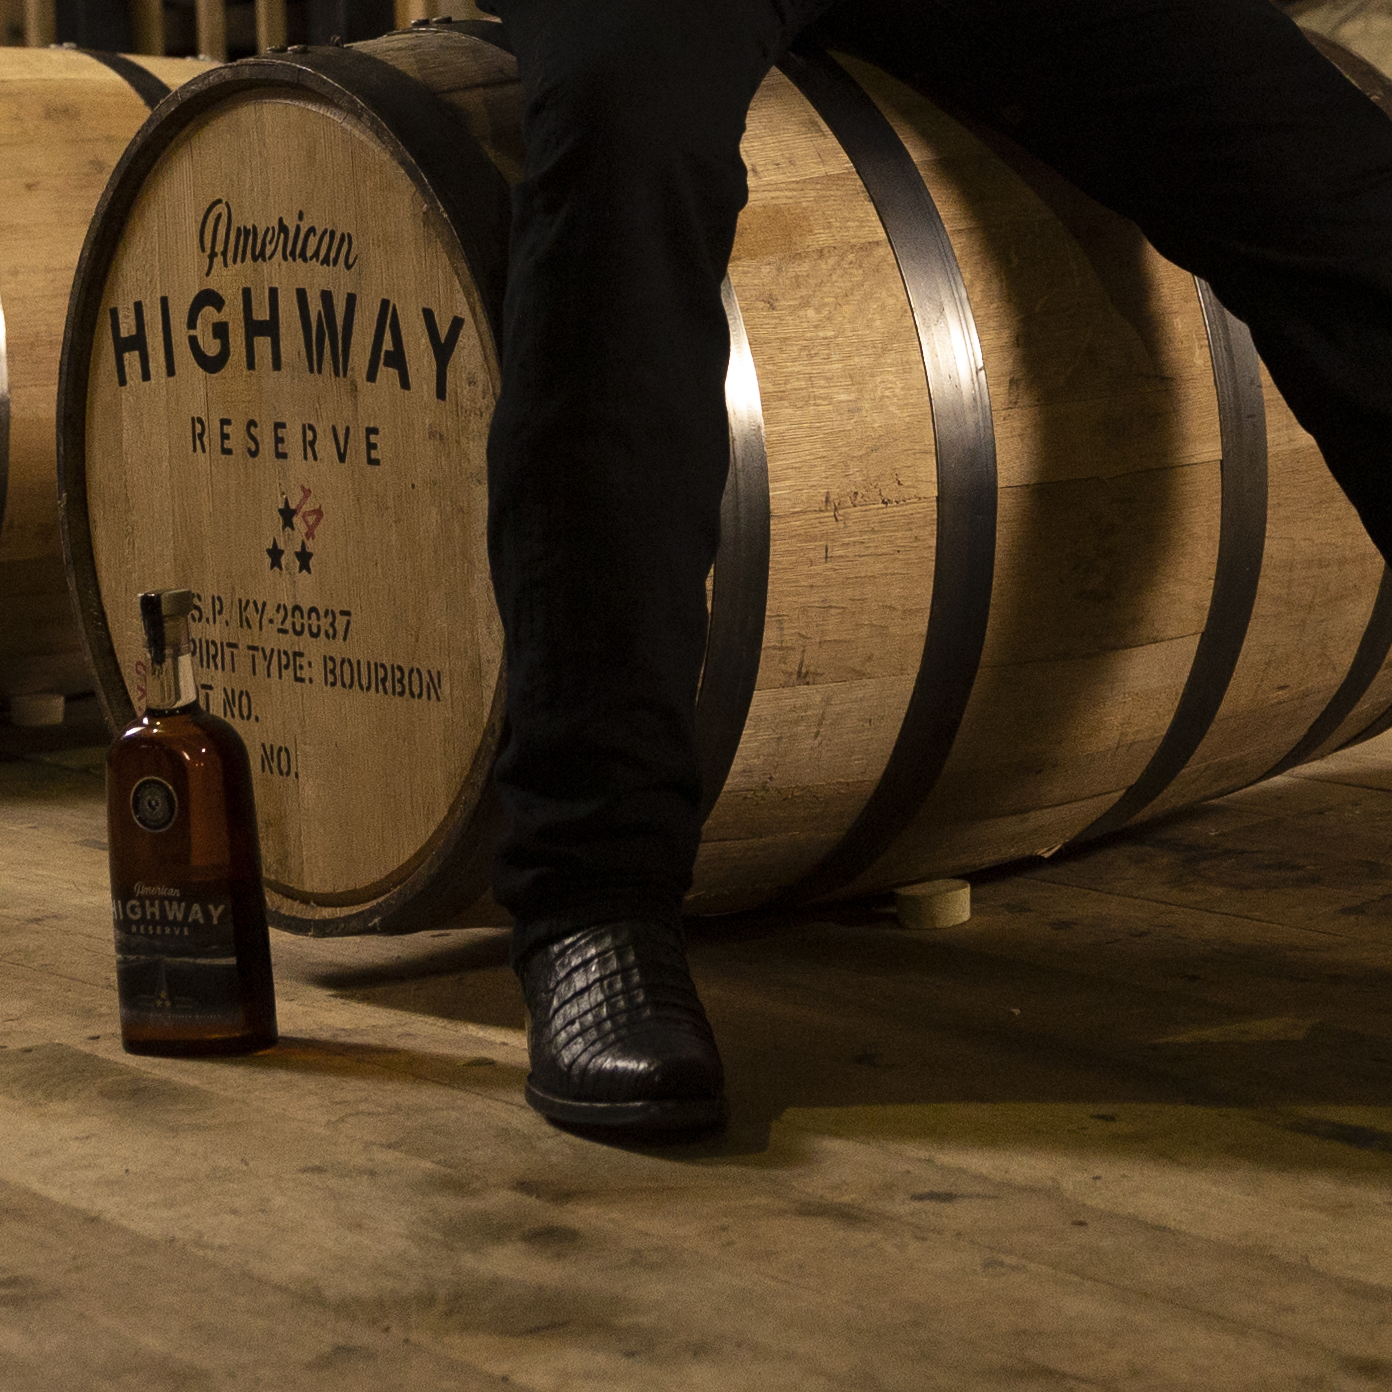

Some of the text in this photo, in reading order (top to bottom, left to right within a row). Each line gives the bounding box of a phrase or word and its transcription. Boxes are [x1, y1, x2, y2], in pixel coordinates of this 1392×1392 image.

[199, 198, 358, 277] American
[109, 286, 465, 401] HIGHWAY
[190, 416, 381, 466] RESERVE
[189, 592, 353, 642] S.P. KY-20037
[190, 636, 443, 703] PIRIT TYPE: BOURBON
[222, 686, 260, 723] NO.
[260, 742, 299, 781] NO.
